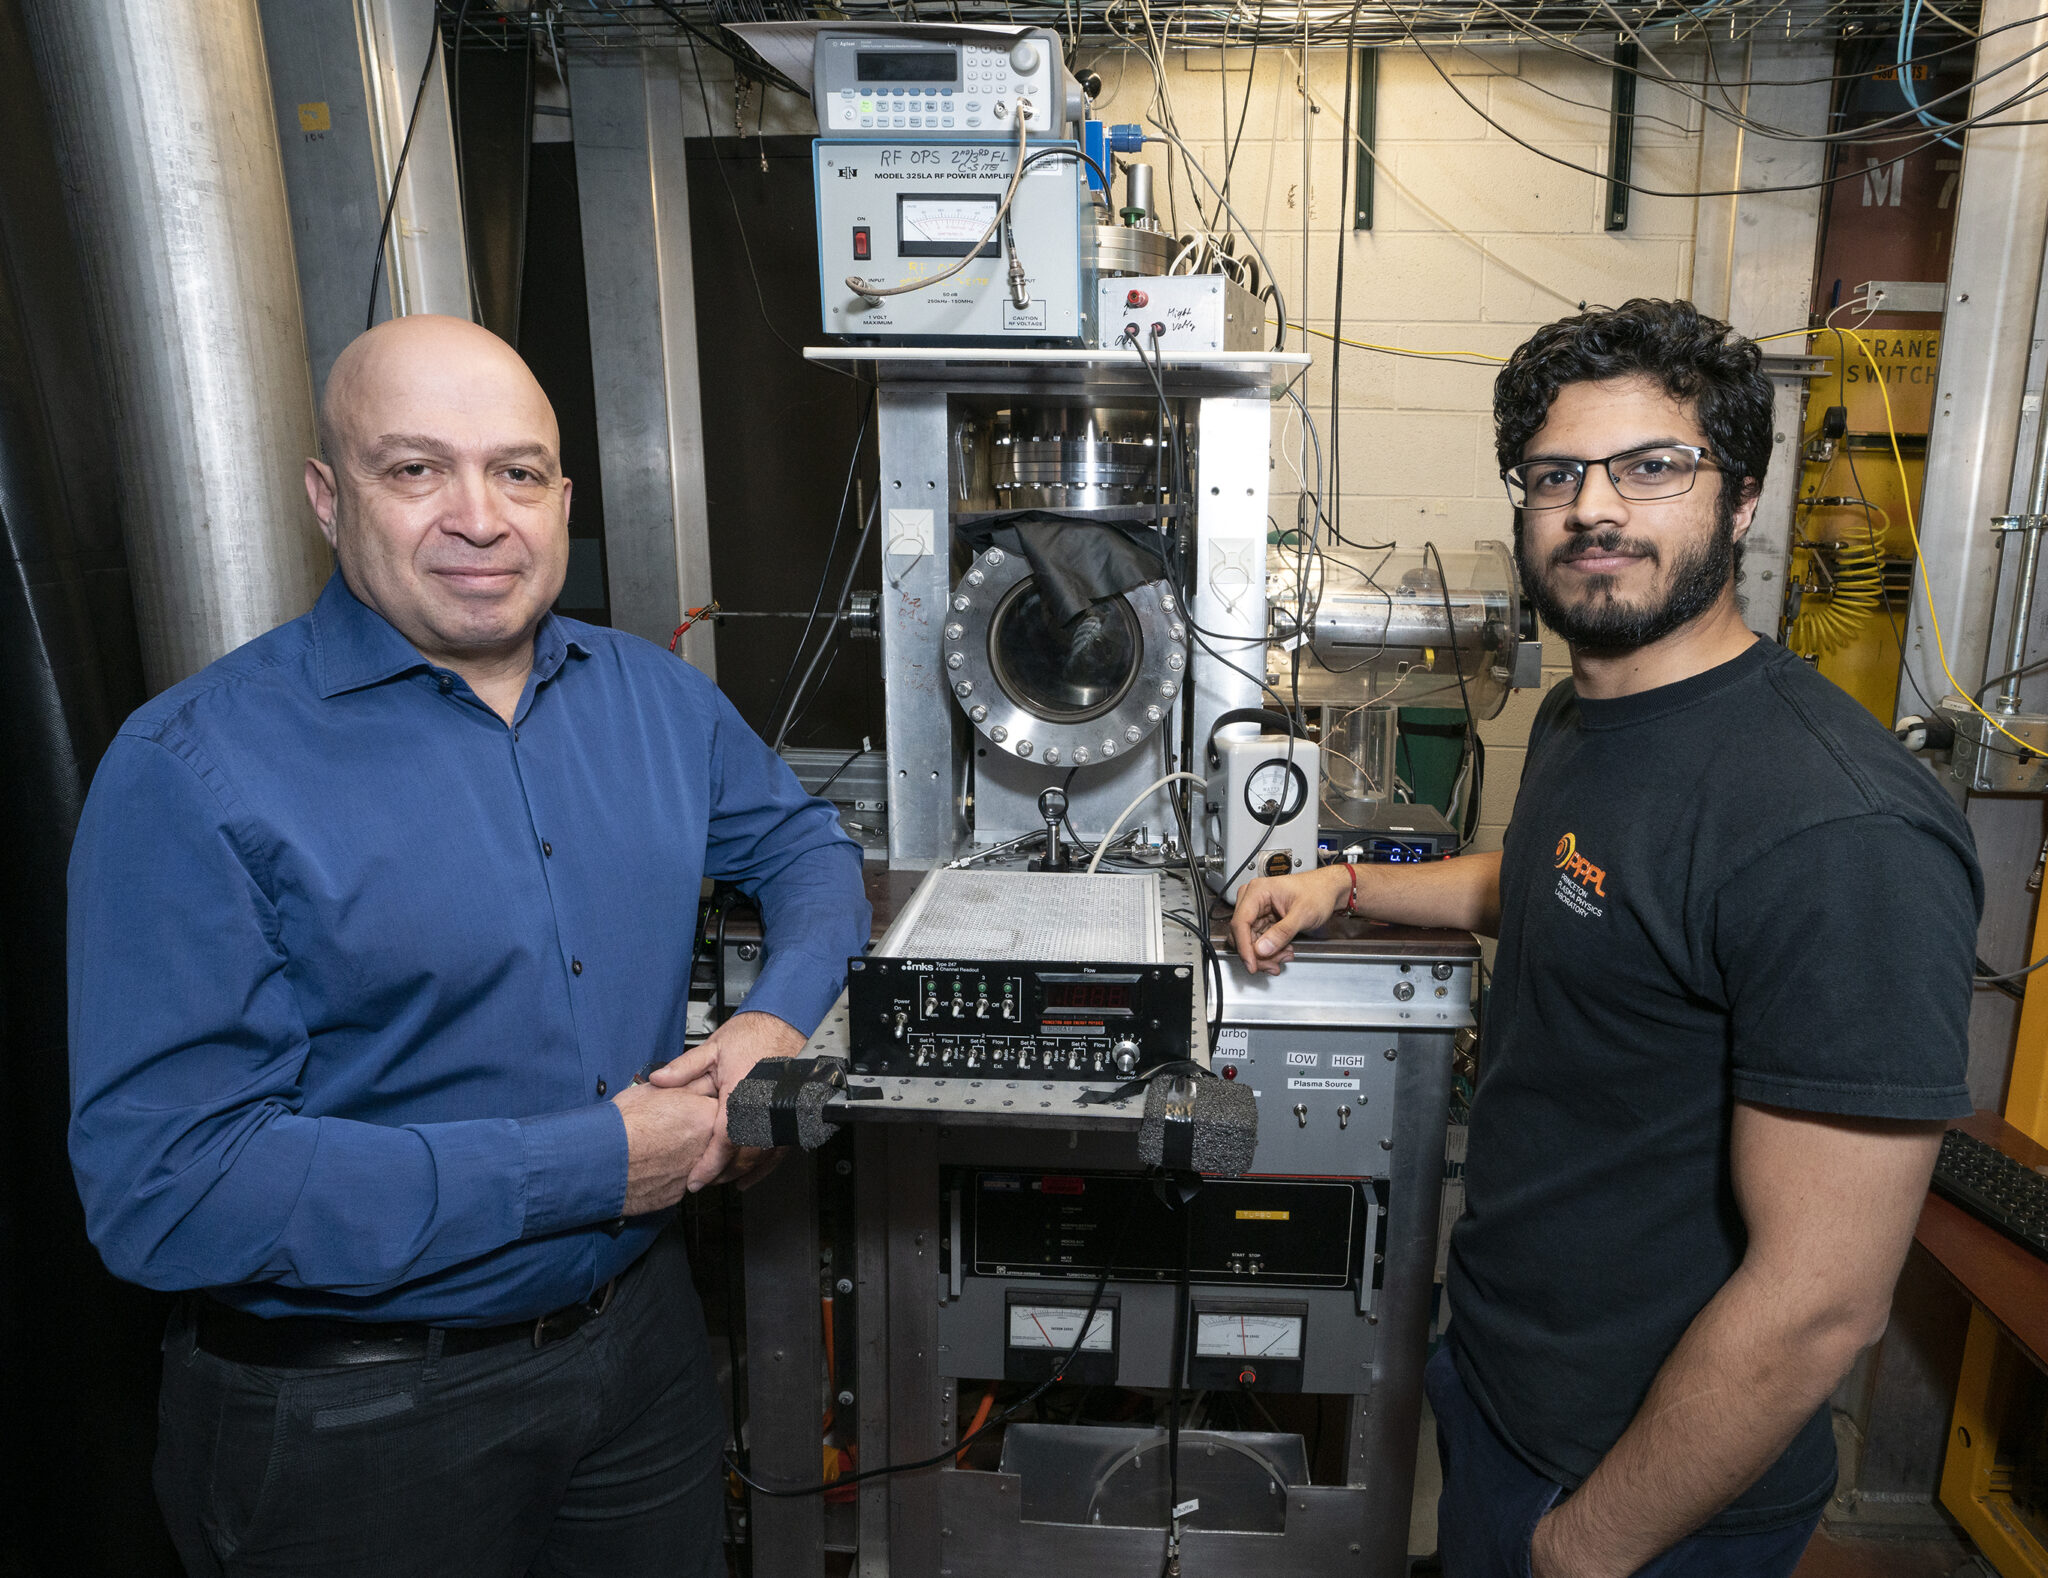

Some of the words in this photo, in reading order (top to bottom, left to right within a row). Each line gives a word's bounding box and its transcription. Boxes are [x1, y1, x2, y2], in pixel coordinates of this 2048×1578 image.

[880, 150, 902, 166] RF
[910, 150, 940, 164] OPS
[991, 151, 1008, 162] FL
[1862, 158, 1904, 206] M
[1858, 338, 1937, 358] CRANE
[1847, 365, 1936, 384] SWITCH
[1560, 872, 1588, 898] PRINCETON
[1554, 888, 1590, 918] LABORATORY
[1558, 880, 1576, 900] PLASMA
[1575, 896, 1602, 917] PHYSICS
[912, 962, 934, 971] mks
[1221, 1029, 1247, 1038] urbo
[1214, 1046, 1246, 1057] Pump
[1289, 1054, 1316, 1064] LOW
[1334, 1057, 1363, 1066] HIGH
